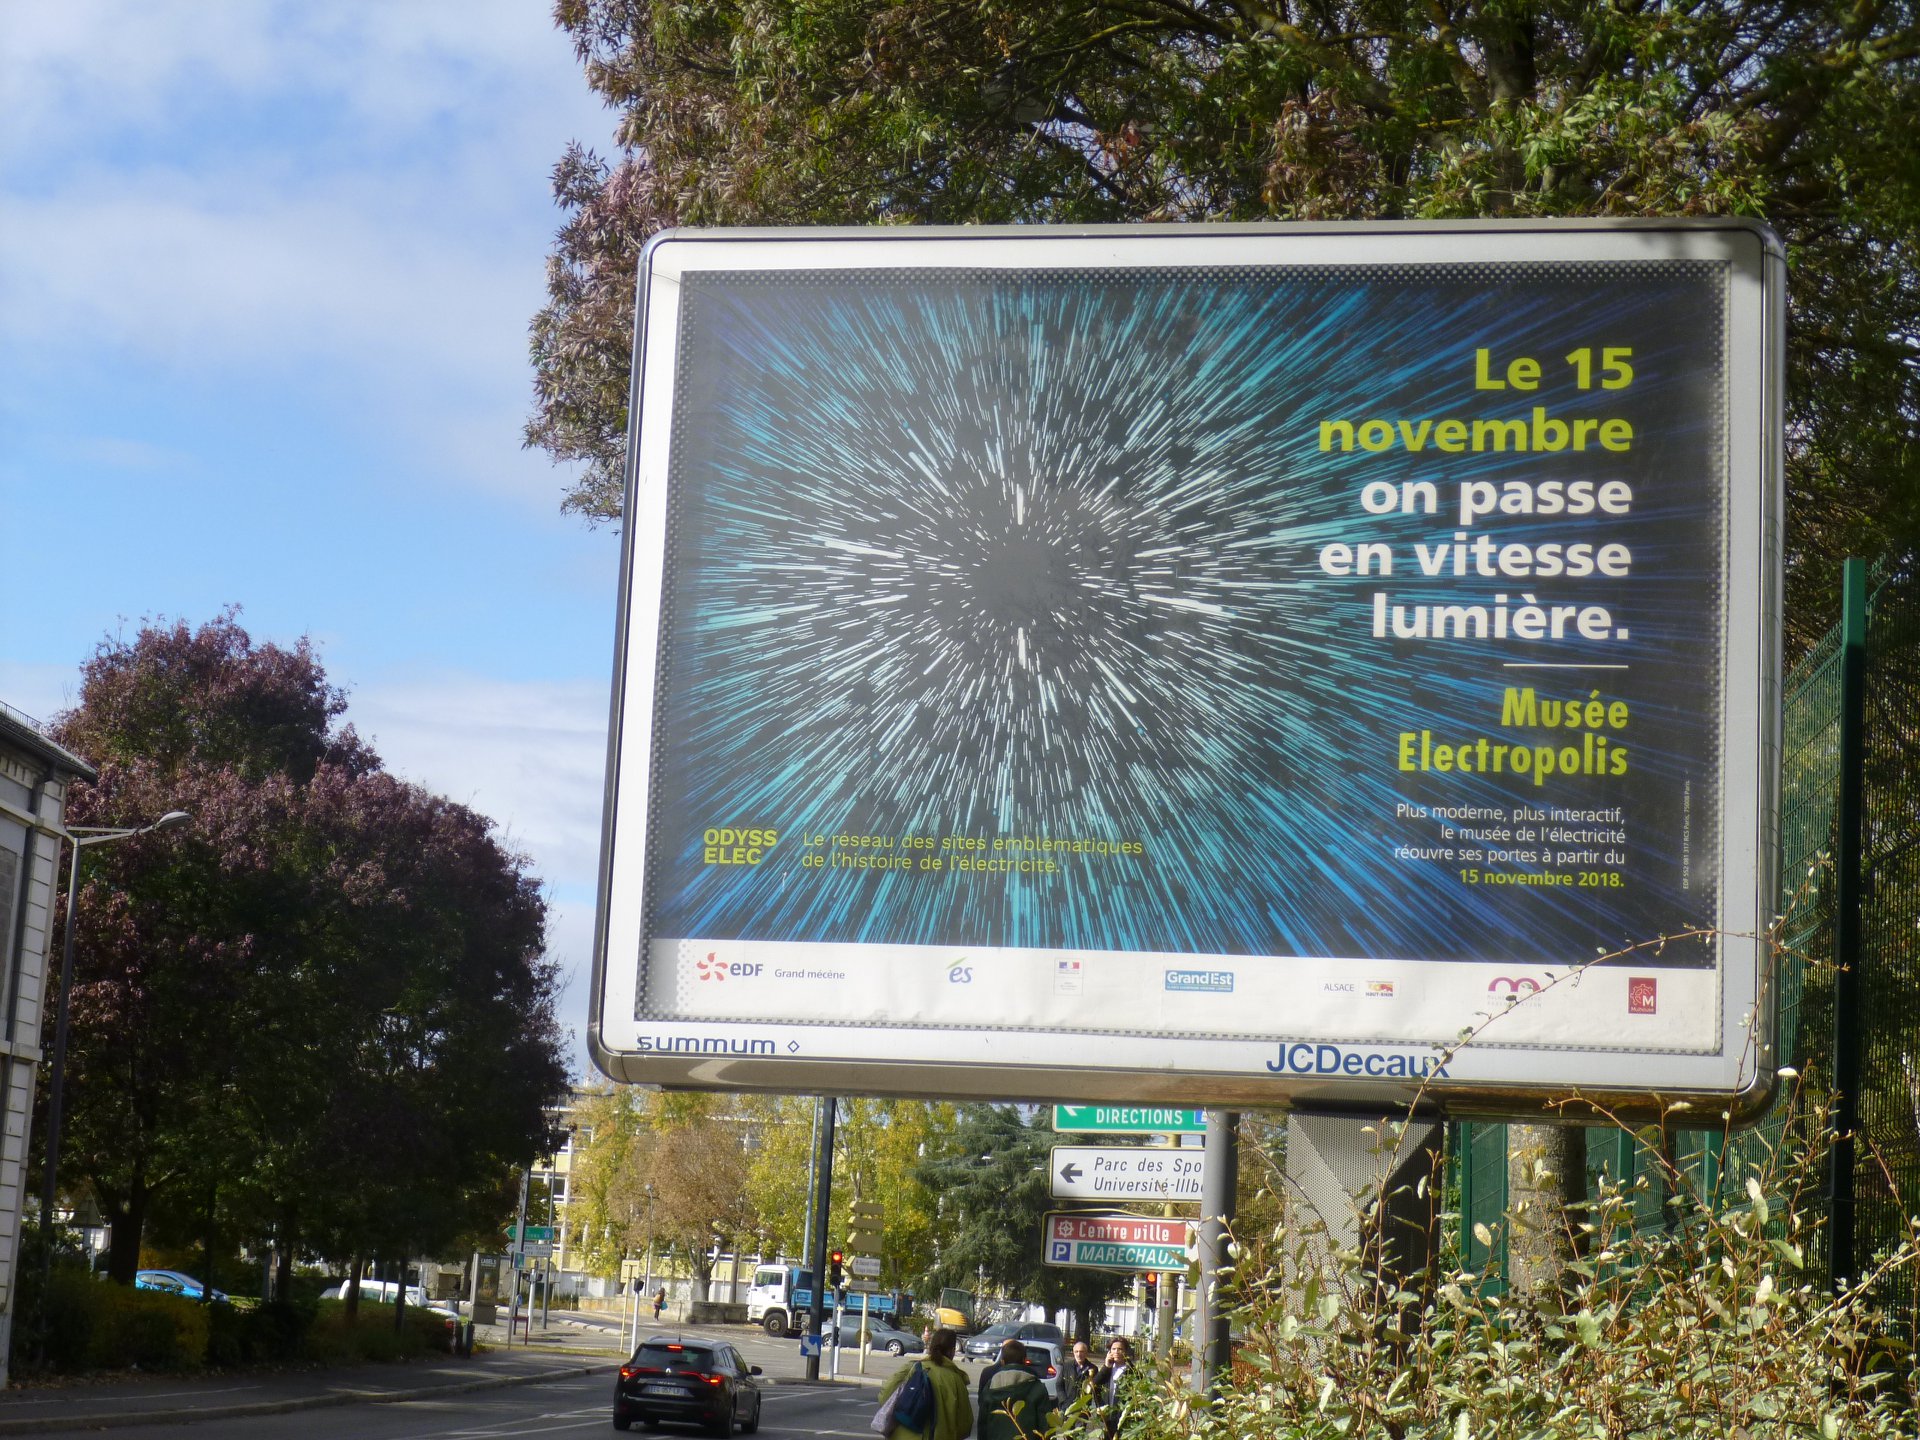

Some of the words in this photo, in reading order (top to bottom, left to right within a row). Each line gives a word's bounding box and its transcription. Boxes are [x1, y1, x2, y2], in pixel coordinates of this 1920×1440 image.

[1474, 348, 1542, 390] Le
[1565, 347, 1634, 390] 15
[1318, 406, 1634, 452] novembre
[1360, 480, 1437, 514] on
[1459, 480, 1633, 526] passe
[1319, 543, 1392, 576] en
[1414, 531, 1632, 577] vitesse
[1372, 592, 1629, 640] lumière.
[1501, 687, 1629, 729] Musée
[1398, 729, 1628, 786] Electropolis
[1396, 803, 1427, 819] Plus
[1432, 804, 1508, 822] moderne,
[1513, 805, 1545, 824] plus
[1550, 807, 1625, 825] interactif,
[703, 828, 777, 847] ODYSS
[803, 832, 824, 846] Le
[832, 830, 894, 848] réseau
[902, 833, 934, 849] des
[942, 834, 986, 850] sites
[993, 834, 1143, 856] emblématiques
[1441, 824, 1454, 839] le
[1459, 825, 1510, 841] musée
[1516, 826, 1535, 842] de
[703, 847, 761, 865] ELEC
[802, 852, 824, 867] de
[919, 855, 942, 870] de
[1394, 844, 1454, 860] réouvre
[1458, 848, 1482, 861] ses
[1487, 848, 1537, 865] portes
[1542, 847, 1551, 862] à
[1557, 848, 1600, 867] partir
[1604, 849, 1625, 865] du
[1459, 869, 1479, 884] 15
[1484, 869, 1573, 886] novembre
[1578, 871, 1625, 888] 2018.
[774, 968, 805, 979] Grand
[807, 968, 845, 979] mécène
[1323, 983, 1355, 992] ALSACE
[1642, 995, 1654, 1007] M
[636, 1036, 776, 1054] summum
[1265, 1043, 1451, 1078] JCDecaux
[1096, 1108, 1183, 1125] DIRECTIONS
[1094, 1156, 1128, 1172] Parc
[1137, 1157, 1163, 1172] des
[1173, 1158, 1202, 1176] Spo
[1078, 1222, 1127, 1240] Centre
[1133, 1224, 1170, 1242] ville
[1055, 1243, 1067, 1259] P
[1079, 1245, 1182, 1266] MARECHAUX
